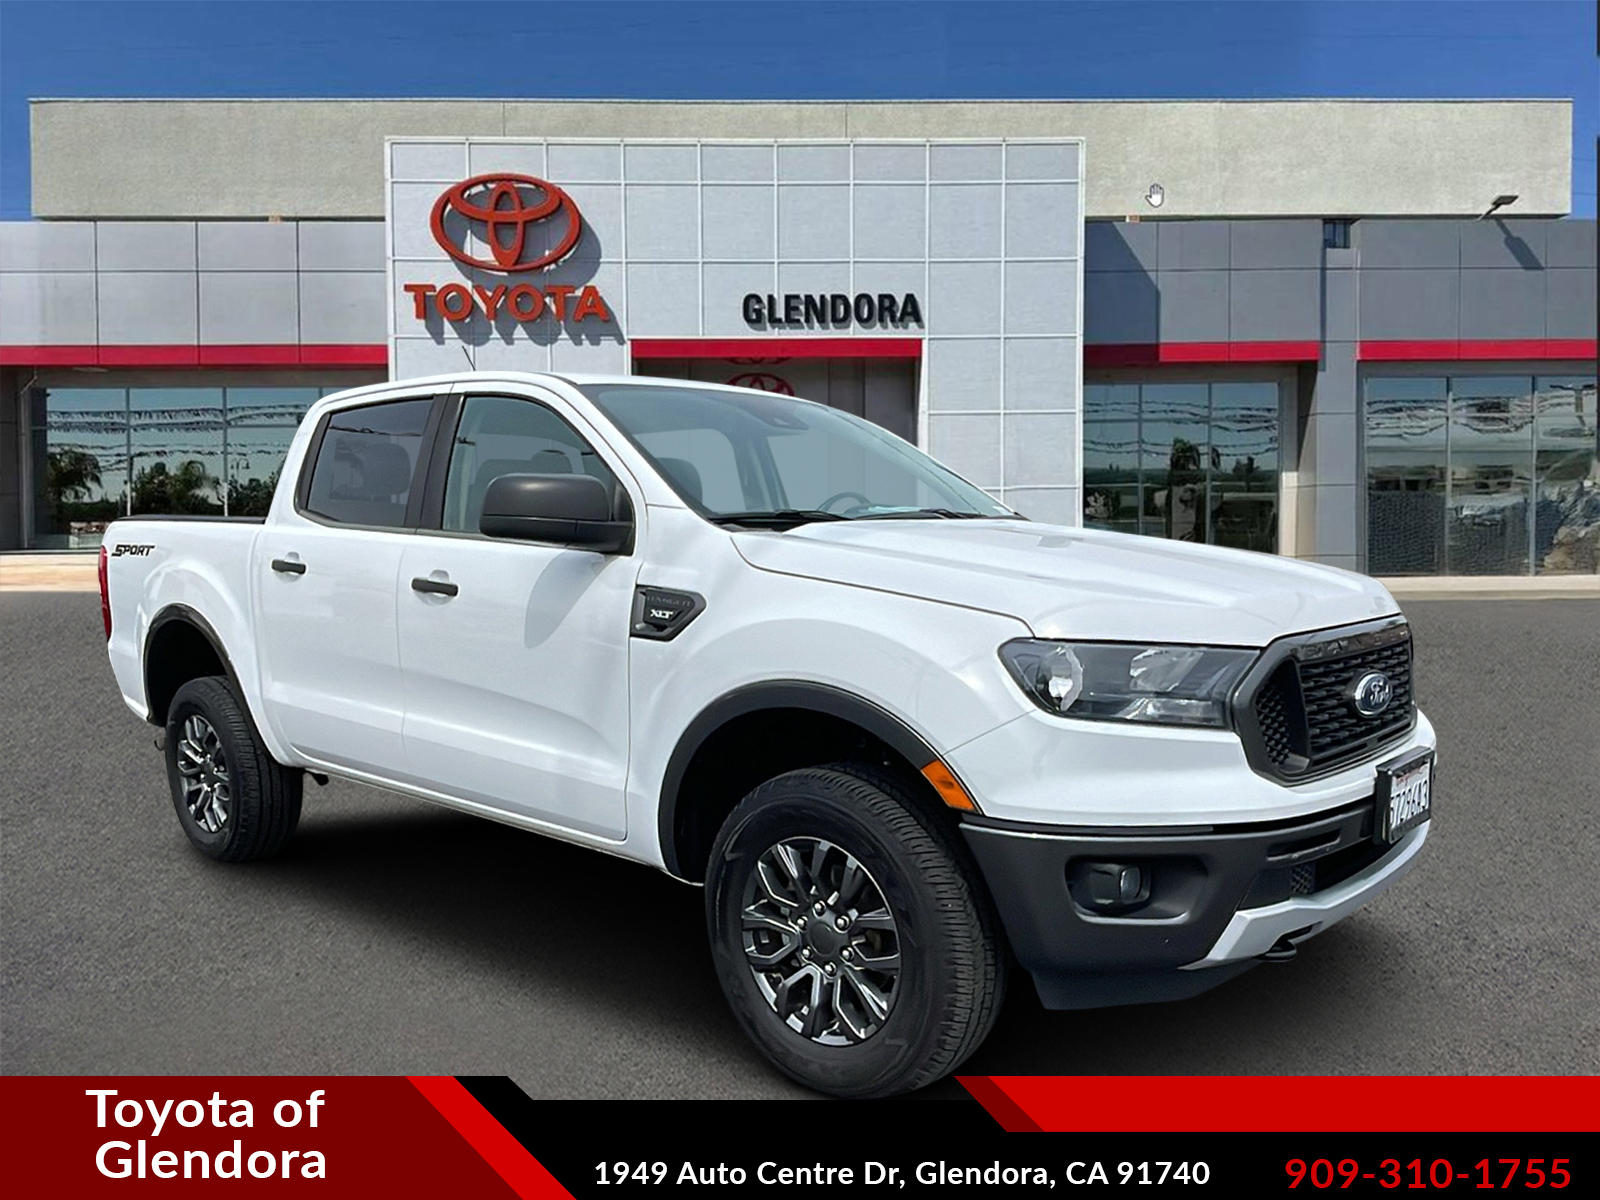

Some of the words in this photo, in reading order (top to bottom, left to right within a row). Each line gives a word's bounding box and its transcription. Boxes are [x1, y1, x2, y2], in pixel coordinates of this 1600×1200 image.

[404, 284, 609, 322] TOYOTA
[742, 293, 922, 326] GLENDORA
[111, 544, 156, 557] SPORT
[650, 608, 674, 619] XLT
